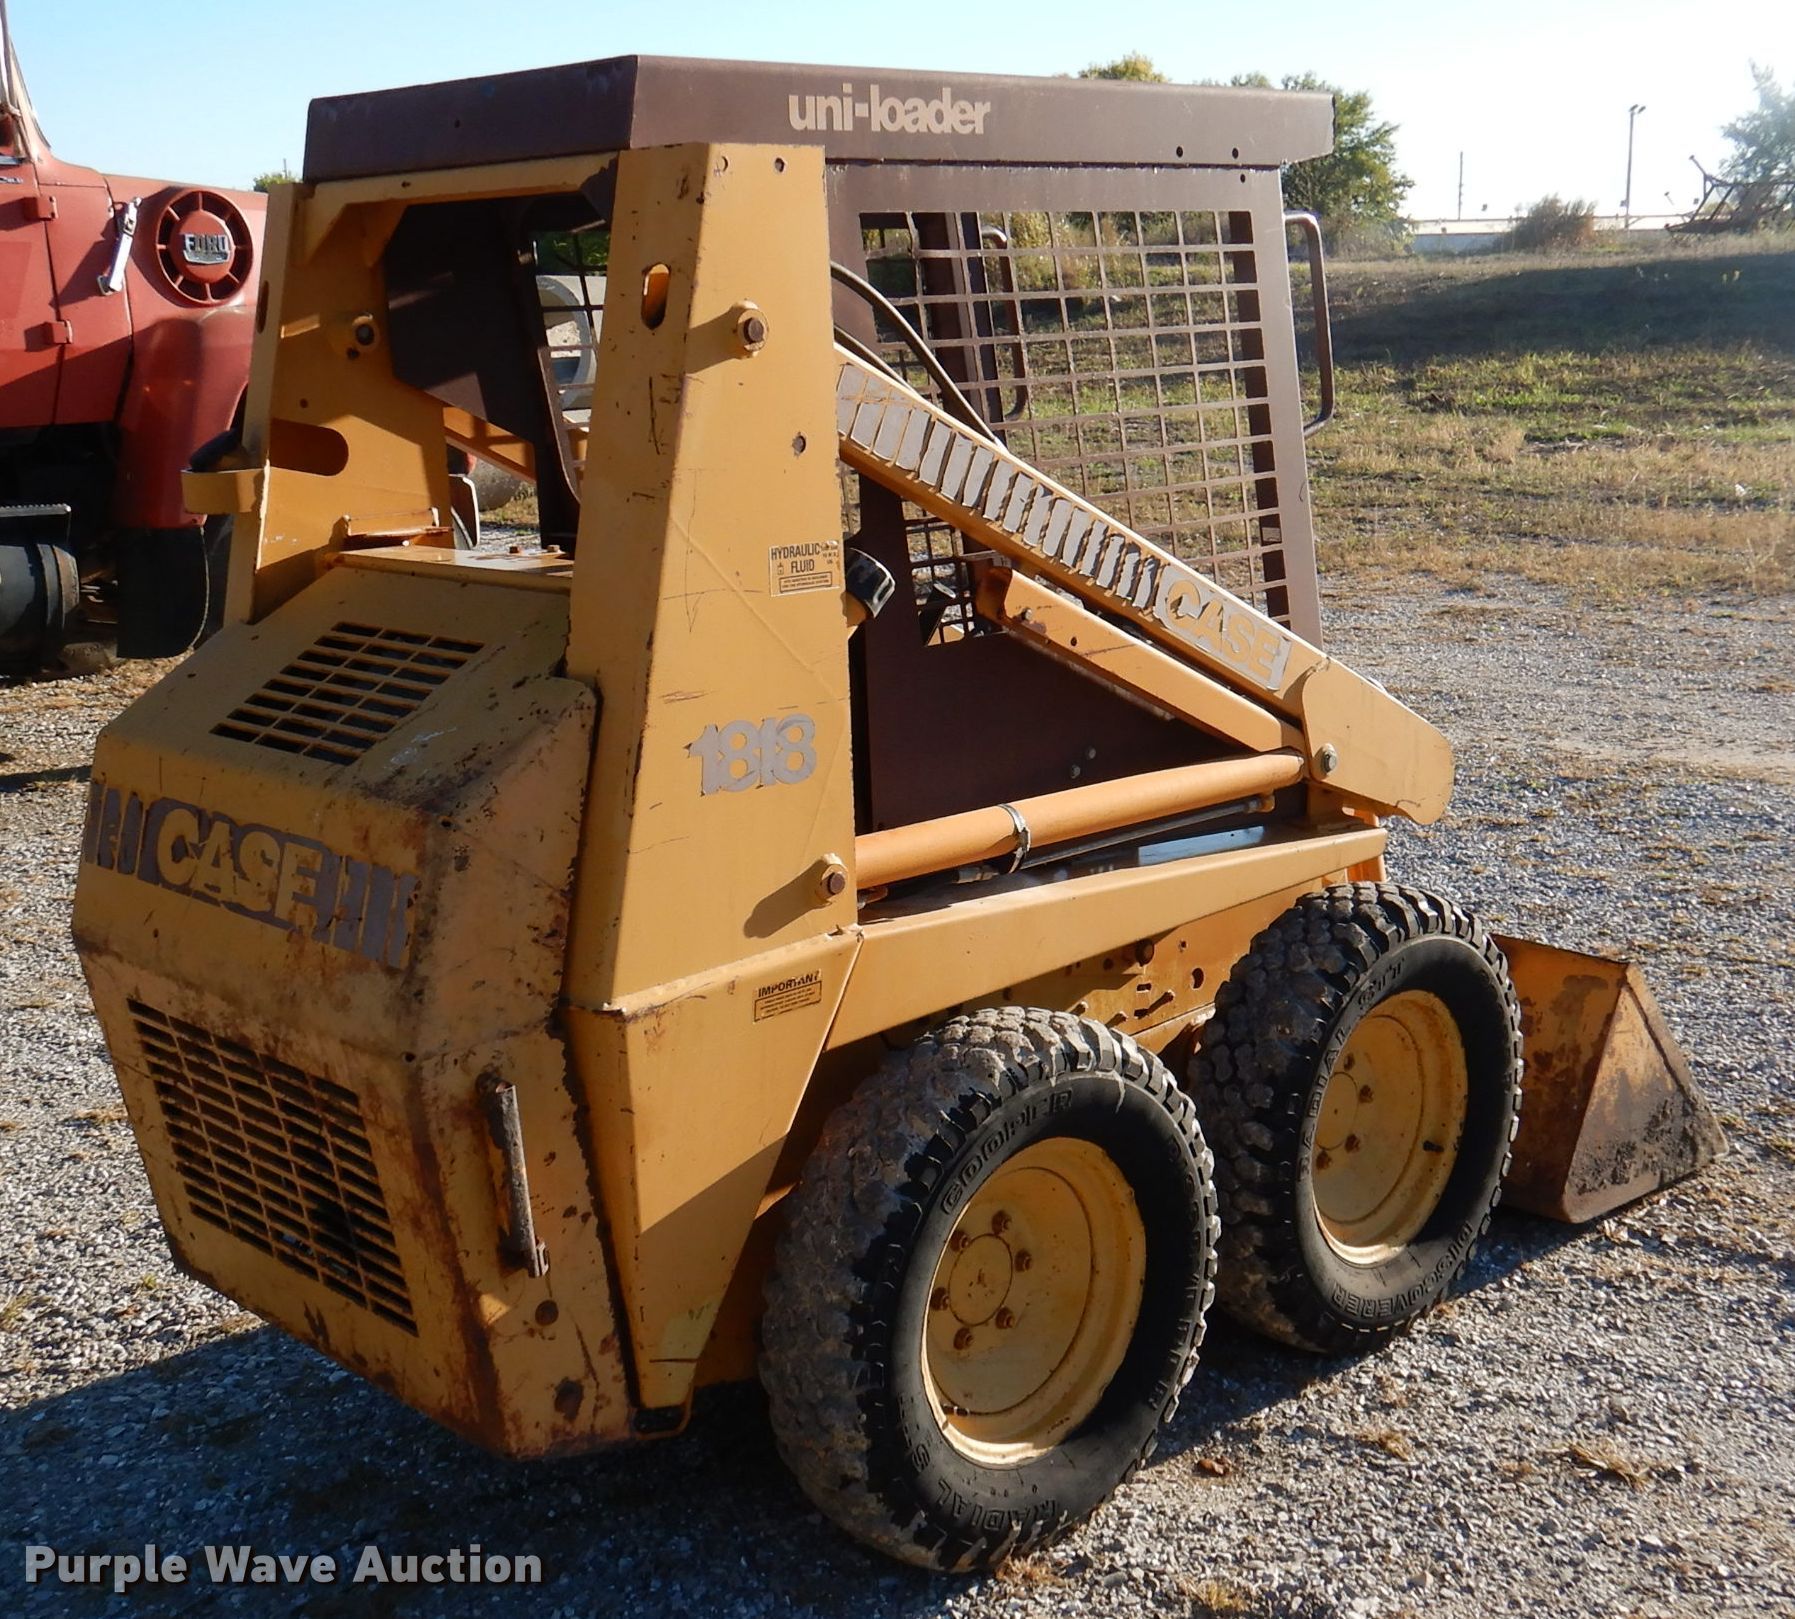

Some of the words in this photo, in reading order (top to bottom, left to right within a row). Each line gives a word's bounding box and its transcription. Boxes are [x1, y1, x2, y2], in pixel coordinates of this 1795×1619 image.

[788, 83, 992, 135] uni-loader
[185, 233, 228, 252] FORD
[771, 542, 821, 561] HYDRAULIC
[790, 558, 815, 574] FLUID
[1167, 579, 1282, 683] CASE
[688, 713, 817, 796] 1818
[156, 807, 323, 938] CASE
